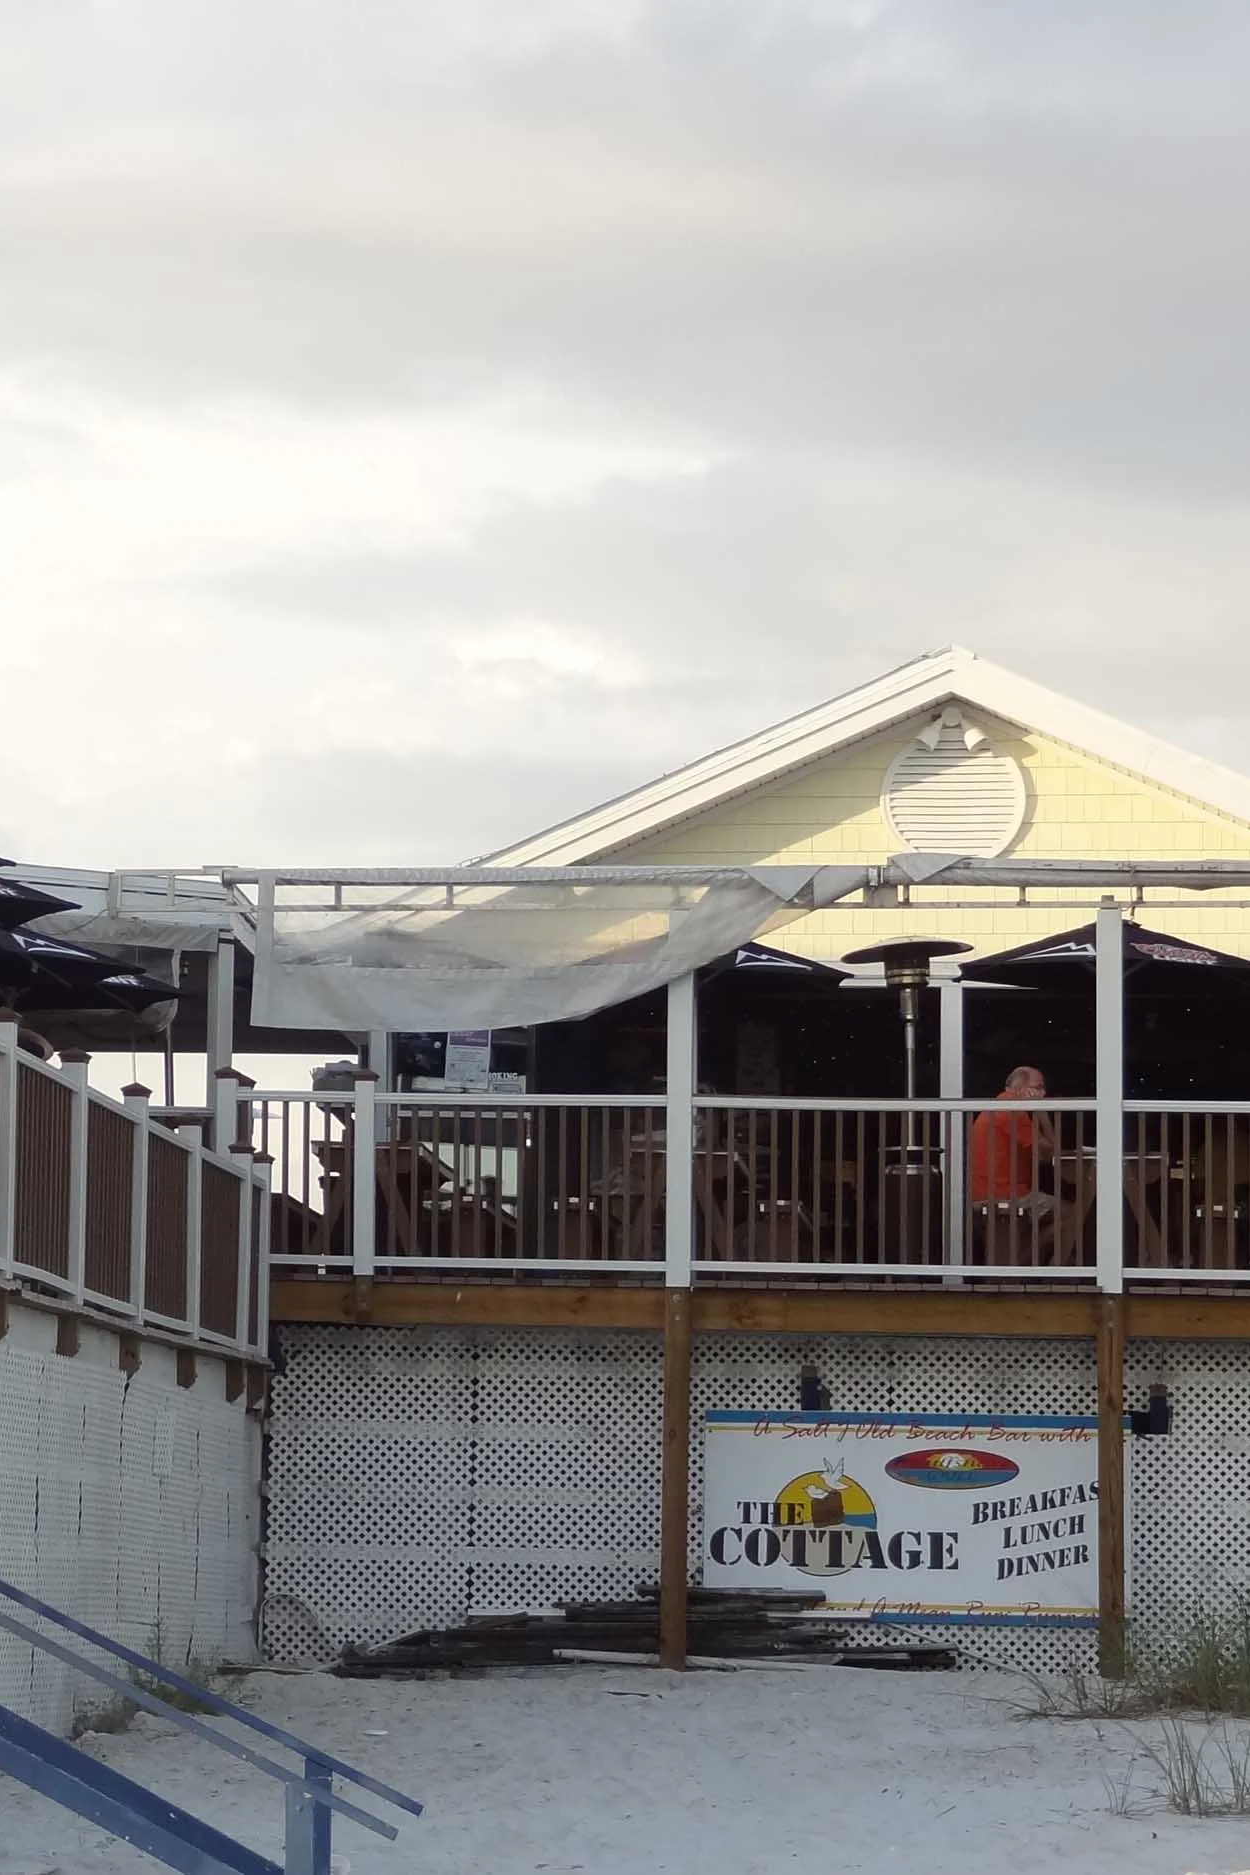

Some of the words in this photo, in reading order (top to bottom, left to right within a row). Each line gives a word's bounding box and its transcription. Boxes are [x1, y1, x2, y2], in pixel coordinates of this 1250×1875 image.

[855, 1419, 894, 1440] Old
[906, 1418, 975, 1441] Beach
[986, 1420, 1031, 1442] Bar
[1039, 1425, 1092, 1443] with
[737, 1501, 805, 1525] THE
[971, 1480, 1100, 1525] BREAKFAS
[710, 1526, 958, 1570] COTTAGE
[1002, 1514, 1086, 1549] LUNCH
[996, 1544, 1090, 1580] DINNER
